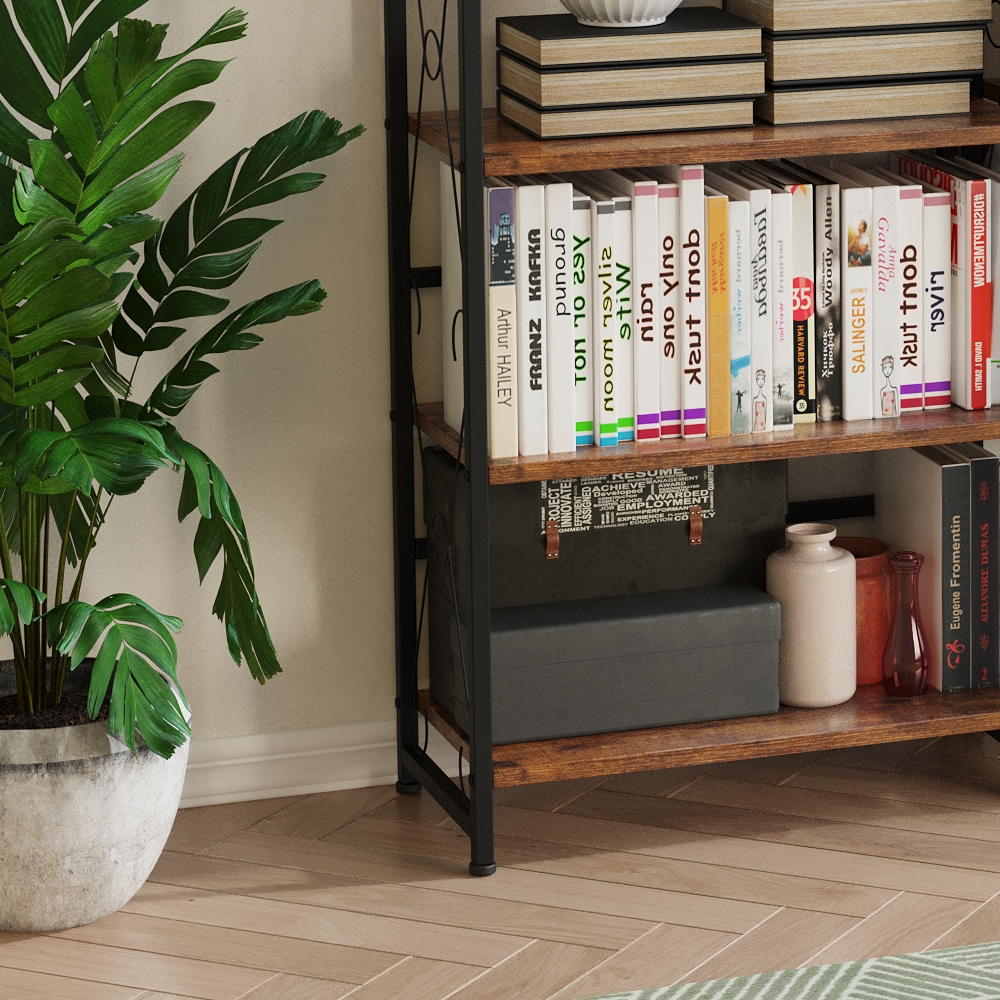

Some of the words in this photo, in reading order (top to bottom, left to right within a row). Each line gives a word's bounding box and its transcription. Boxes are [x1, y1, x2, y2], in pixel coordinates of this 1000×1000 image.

[528, 228, 541, 302] KAFKA
[551, 228, 570, 316] ground
[878, 217, 890, 292] Gavalda
[888, 245, 897, 278] Anna
[824, 248, 834, 307] Woody
[497, 308, 511, 350] Arthur
[797, 325, 805, 364] HARVARD
[852, 297, 866, 374] SALINGER
[530, 318, 542, 390] FRANZ
[497, 354, 512, 407] HAILEY
[797, 367, 805, 396] REVIEW
[548, 488, 560, 522] ROJECT
[560, 482, 572, 528] INNOVATE
[582, 486, 592, 524] ASSIGNED
[592, 482, 646, 492] ACHIEVE
[594, 488, 643, 498] Developed
[617, 496, 709, 511] EMPLOYMENT
[646, 490, 708, 501] AWARDED
[630, 517, 673, 525] EDUCATION
[674, 512, 716, 521] COLY
[950, 515, 961, 587] Fromentin
[981, 523, 989, 568] DUMAS
[950, 591, 961, 630] Eugene
[981, 569, 989, 623] ALEXANDRE
